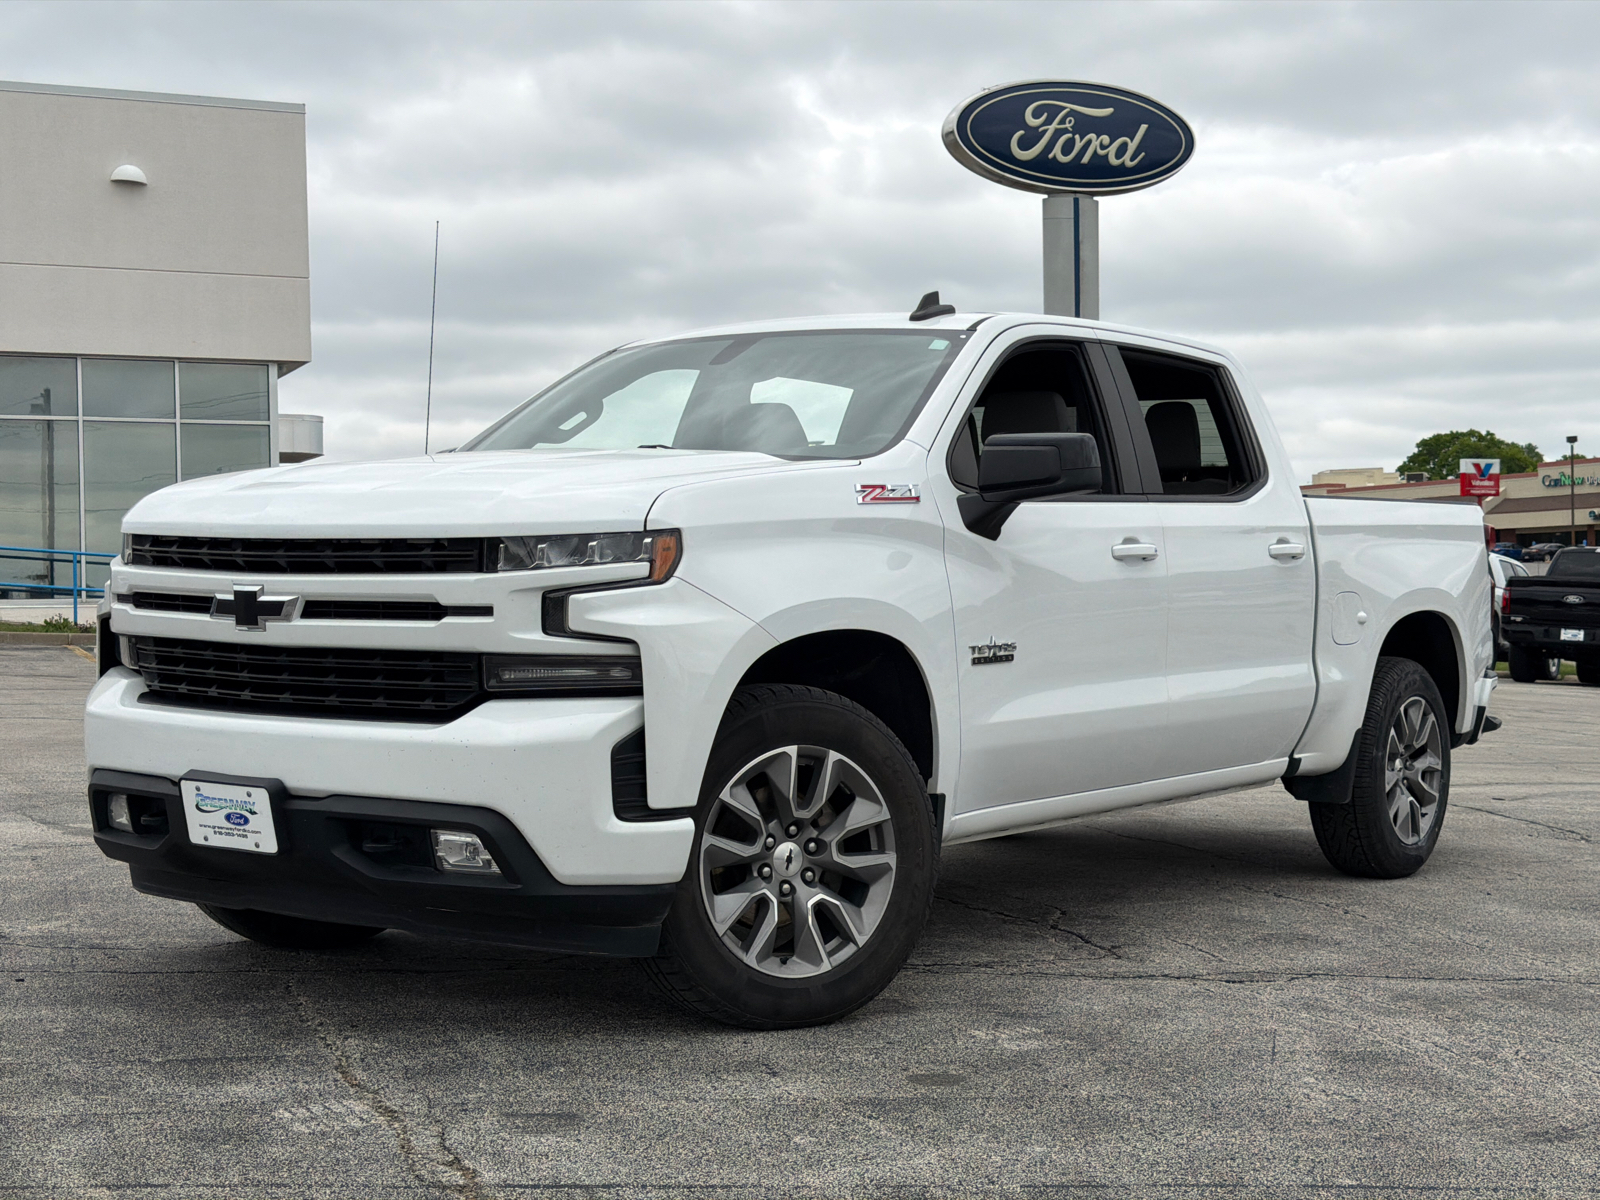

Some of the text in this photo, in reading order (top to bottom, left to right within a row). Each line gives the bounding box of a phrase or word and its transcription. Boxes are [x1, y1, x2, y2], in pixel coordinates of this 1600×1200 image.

[1010, 100, 1149, 168] Ford
[855, 484, 920, 505] Z71
[230, 814, 244, 824] Ford
